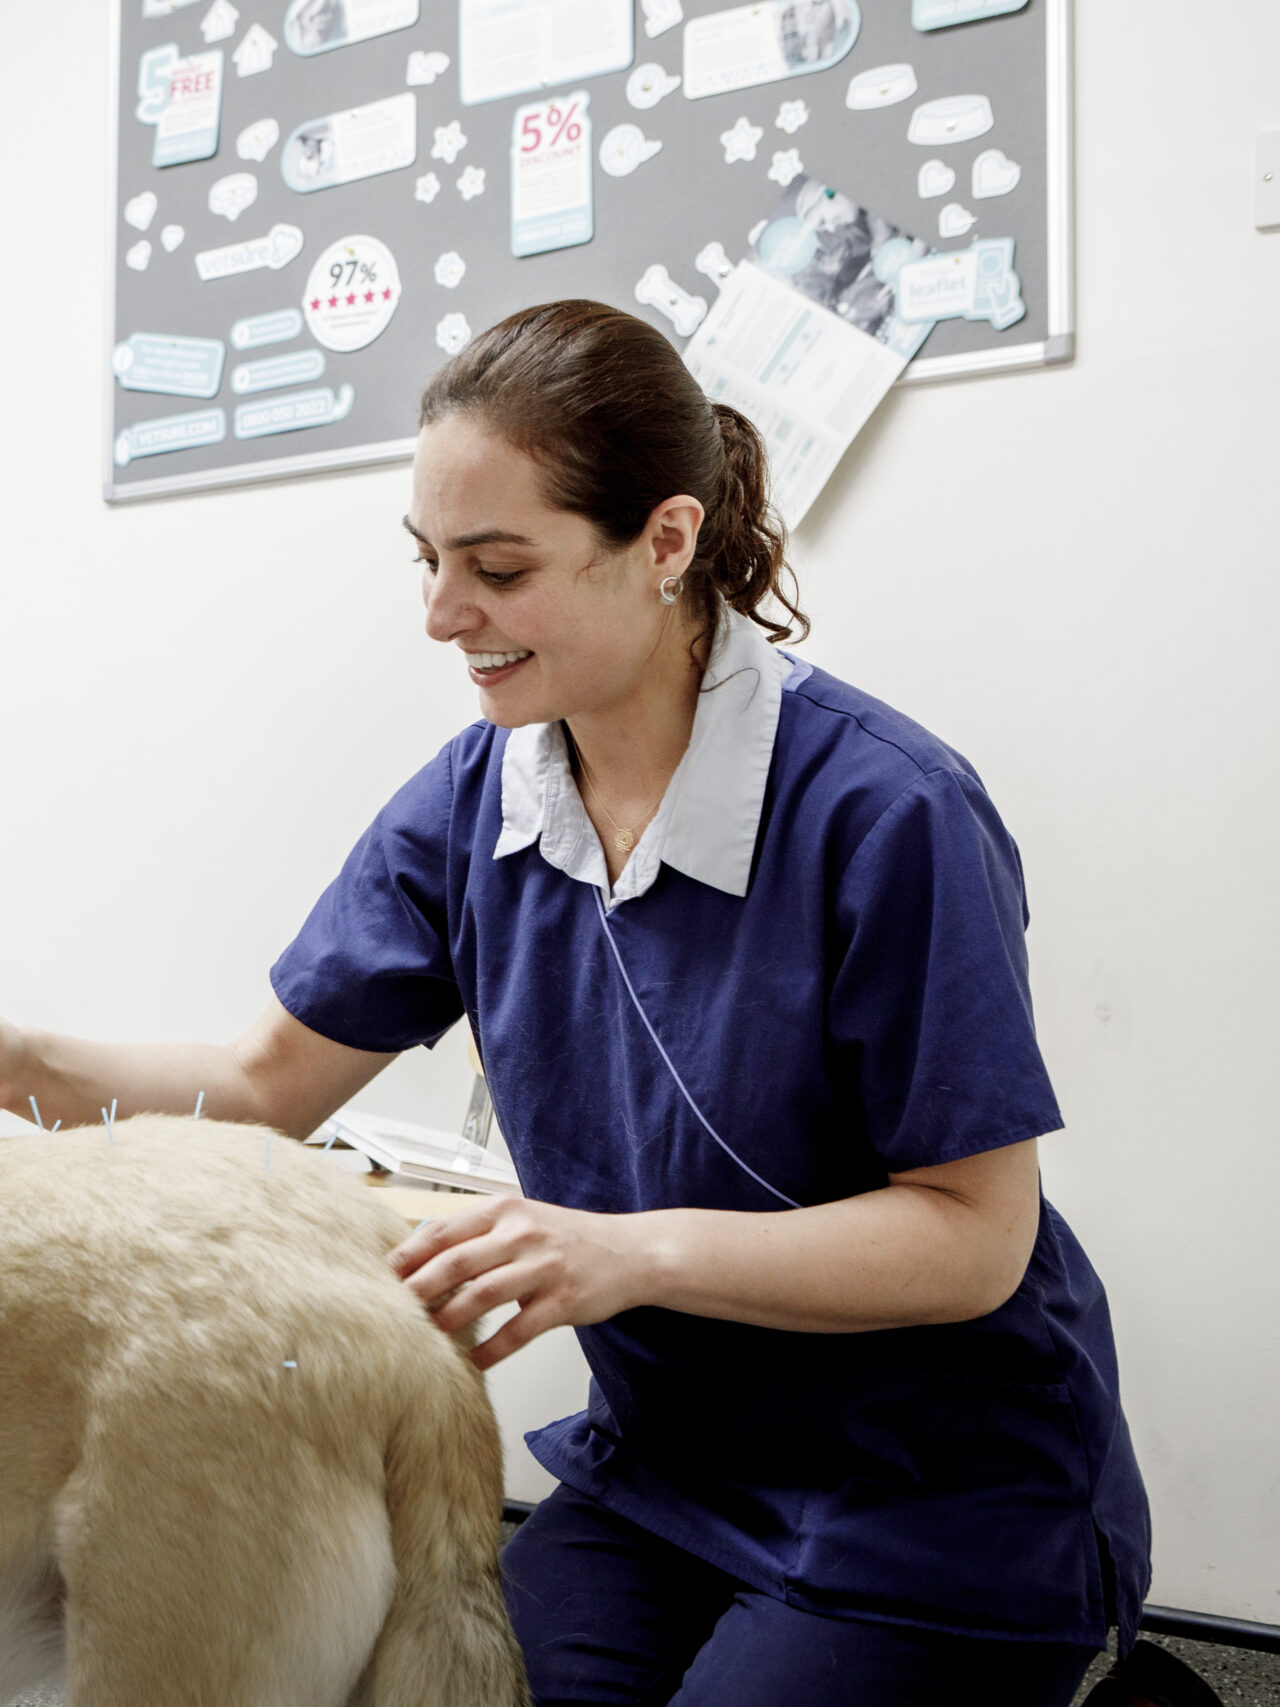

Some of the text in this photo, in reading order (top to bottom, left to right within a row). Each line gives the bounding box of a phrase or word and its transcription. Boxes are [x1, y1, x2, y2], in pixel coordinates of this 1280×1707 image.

[143, 53, 173, 115] 5
[170, 70, 215, 98] FREE
[520, 102, 582, 153] 5%
[329, 260, 377, 288] 97%
[910, 275, 966, 297] leaflet
